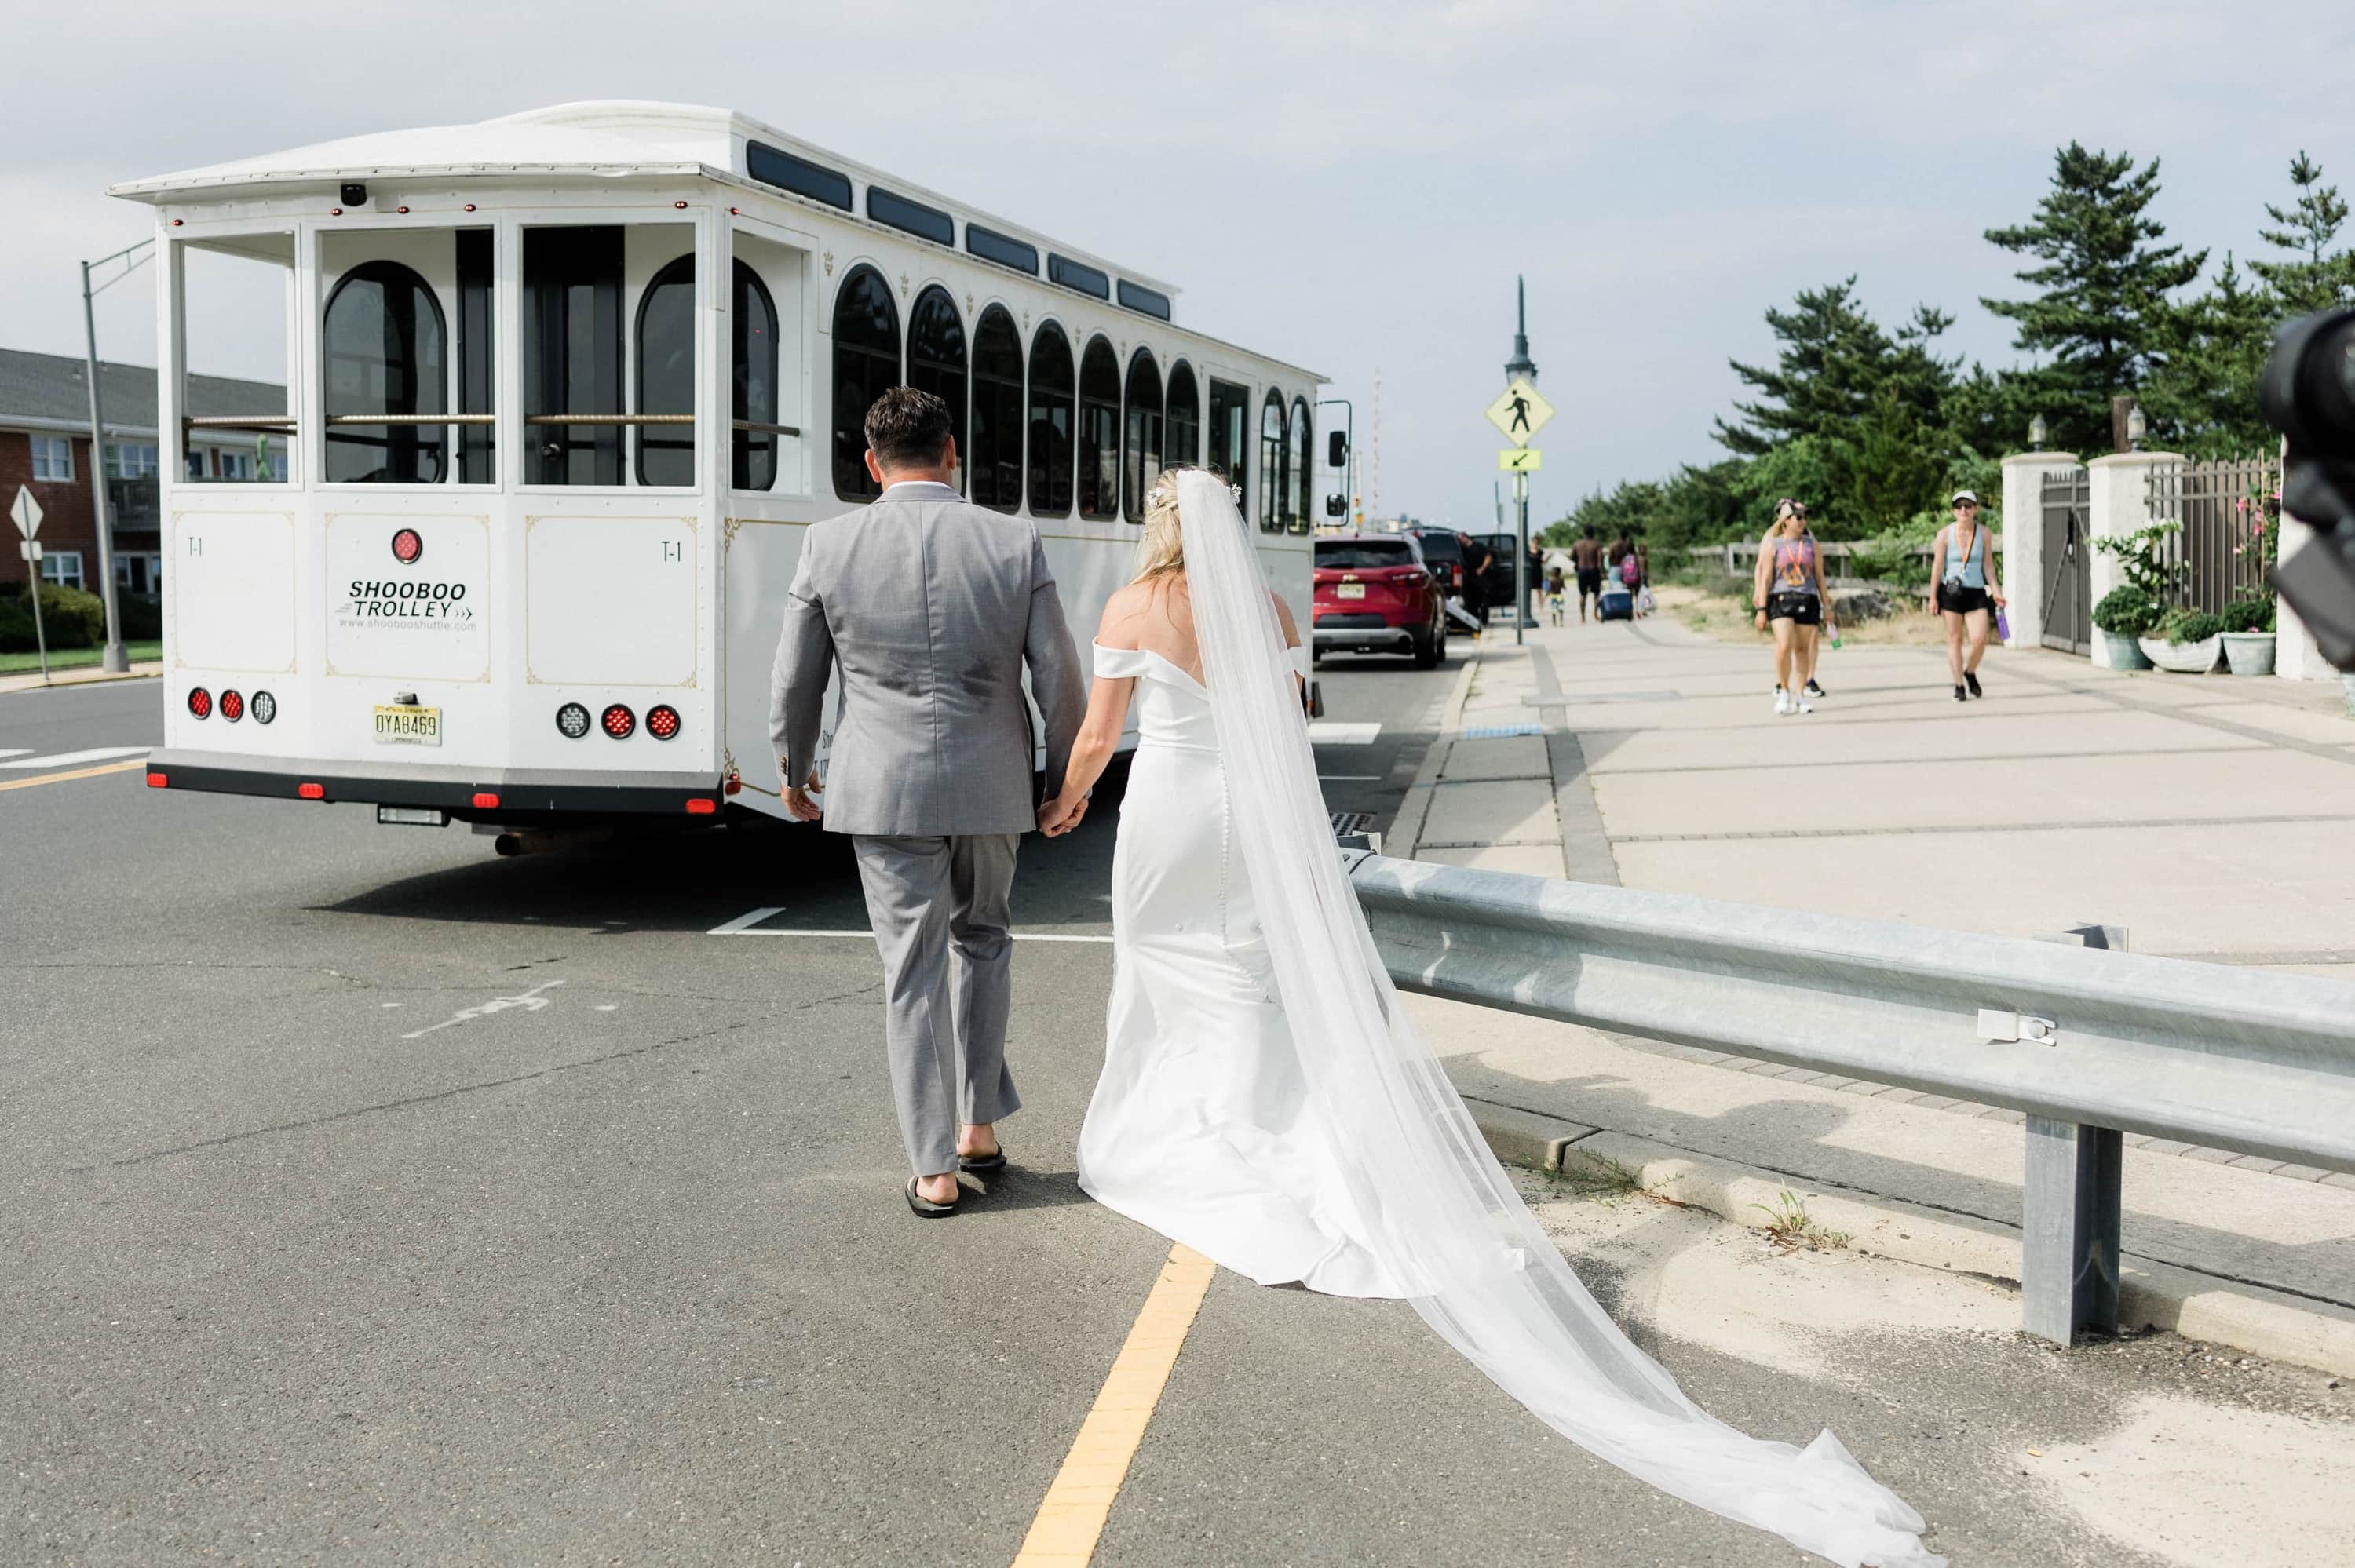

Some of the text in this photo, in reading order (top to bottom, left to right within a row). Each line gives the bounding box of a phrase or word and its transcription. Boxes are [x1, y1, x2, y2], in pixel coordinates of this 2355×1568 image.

[661, 541, 681, 563] T-1
[349, 581, 466, 600] SHOOBOO
[354, 600, 453, 618] TROLLEY
[338, 618, 477, 633] www.shoobooshuttle.com
